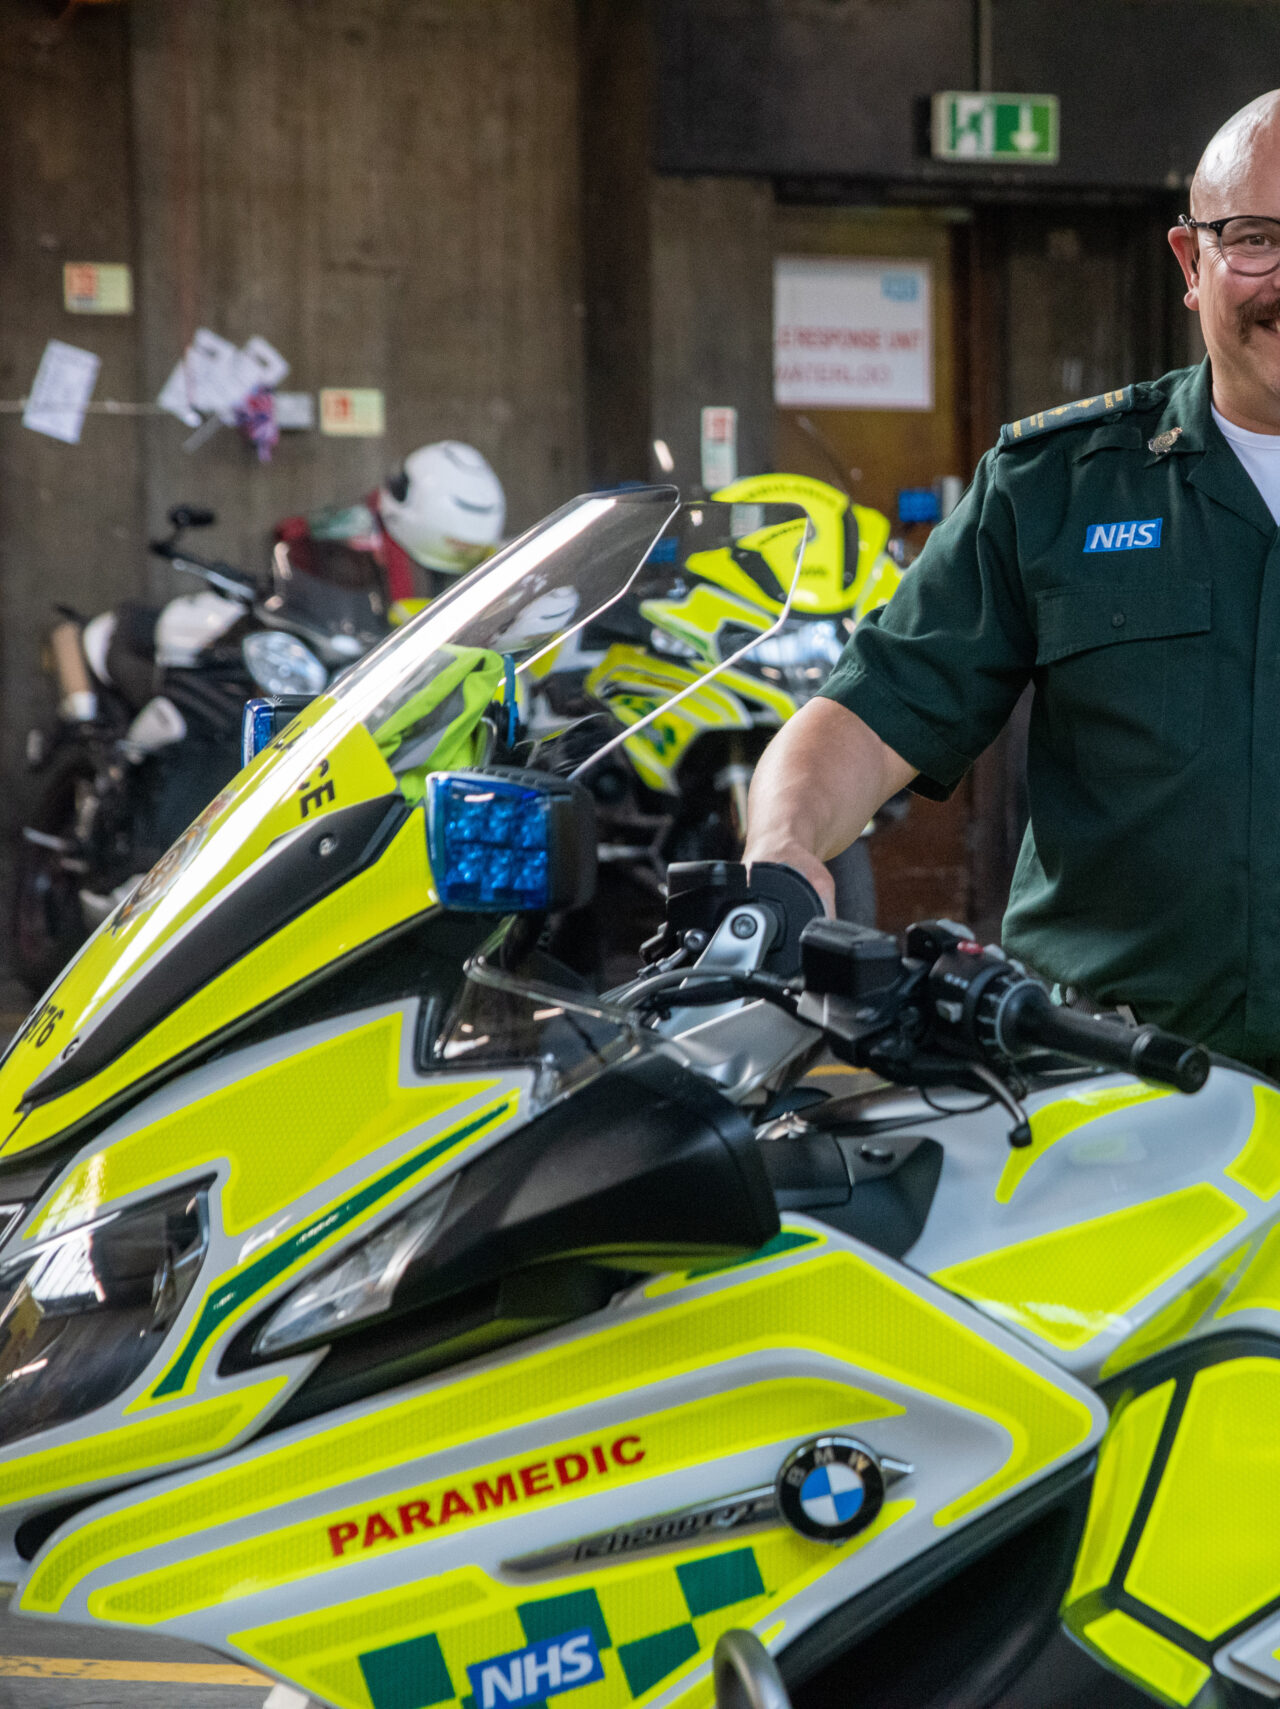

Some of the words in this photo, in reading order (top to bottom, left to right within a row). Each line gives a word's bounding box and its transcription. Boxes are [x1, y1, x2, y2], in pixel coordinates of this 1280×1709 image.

[1090, 523, 1156, 550] NHS
[327, 1435, 646, 1557] PARAMEDIC
[482, 1635, 593, 1709] NHS
